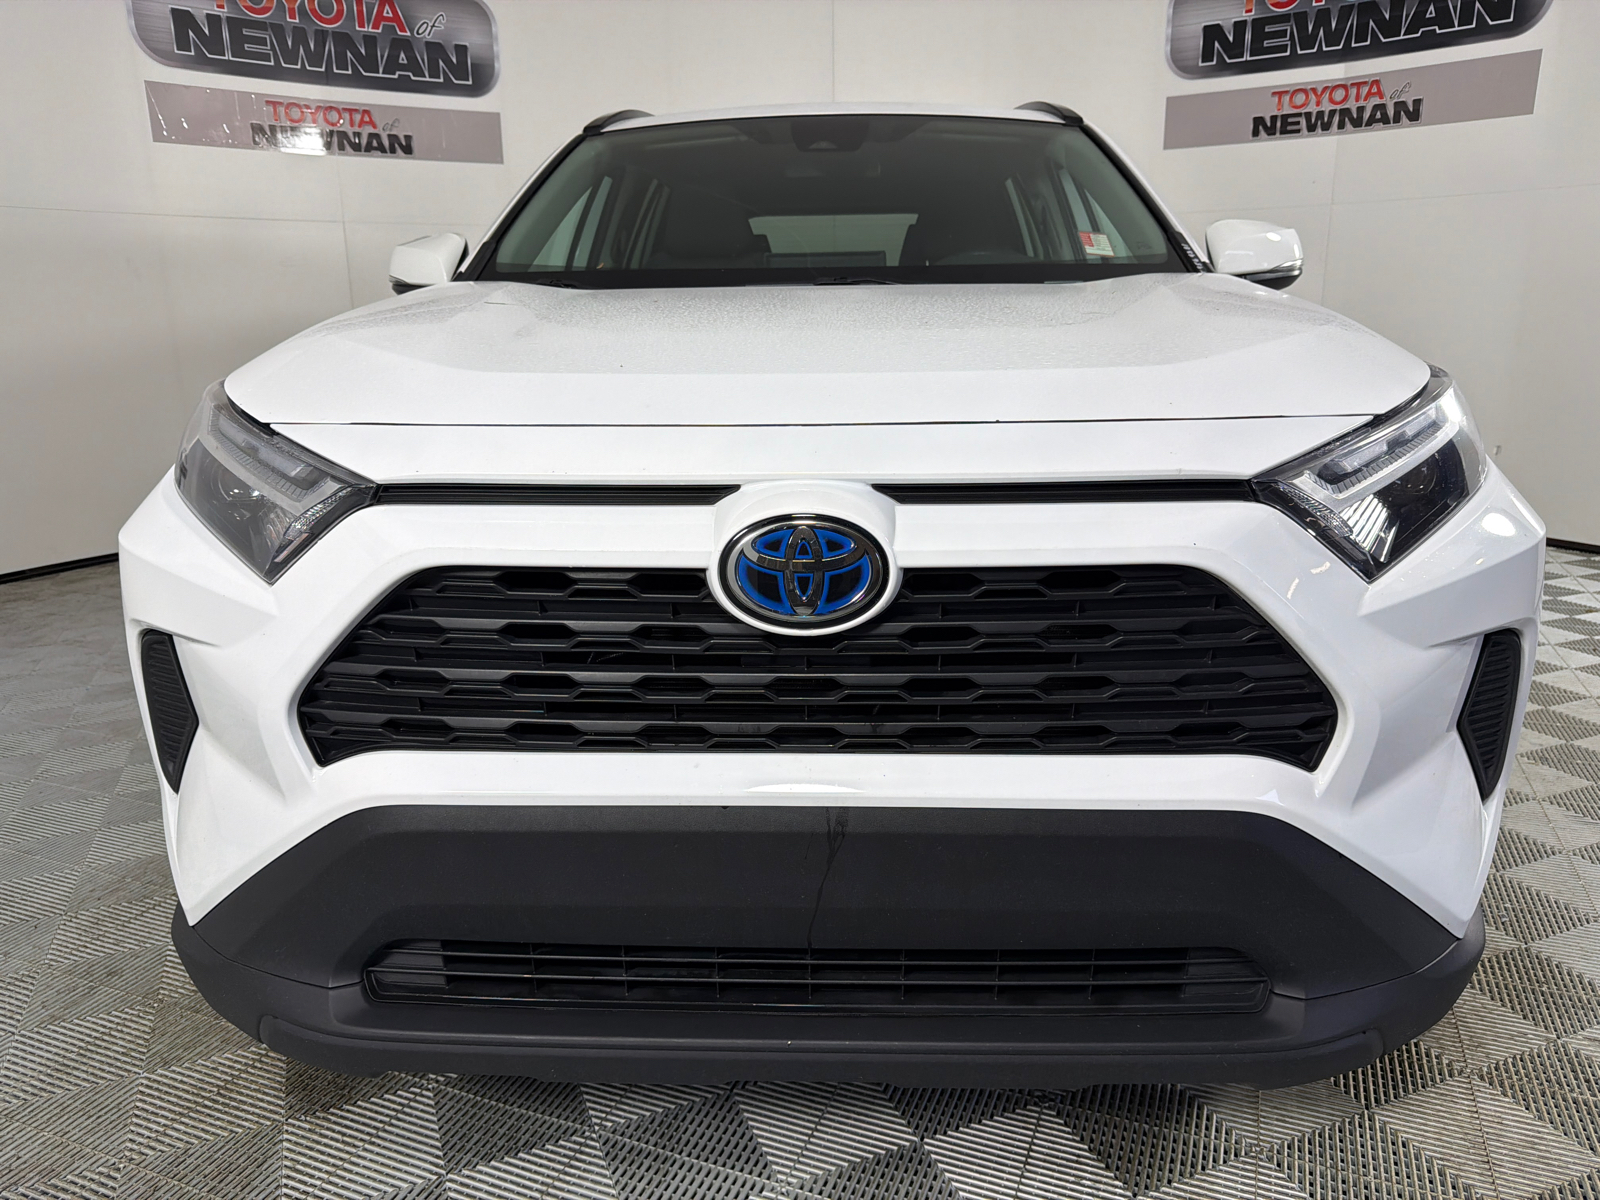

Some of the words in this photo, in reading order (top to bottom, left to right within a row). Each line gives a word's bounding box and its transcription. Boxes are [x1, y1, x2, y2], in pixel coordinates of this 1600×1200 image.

[214, 0, 411, 36] YOTA
[415, 12, 446, 38] of
[1199, 0, 1516, 66] NEWNAN
[169, 6, 473, 85] NEWNAN
[1271, 78, 1385, 112] TOYOTA
[1389, 81, 1412, 100] of
[265, 99, 378, 130] TOYOTA
[382, 117, 400, 133] of
[1252, 98, 1424, 138] NEWNAN
[250, 122, 414, 156] NNAN
